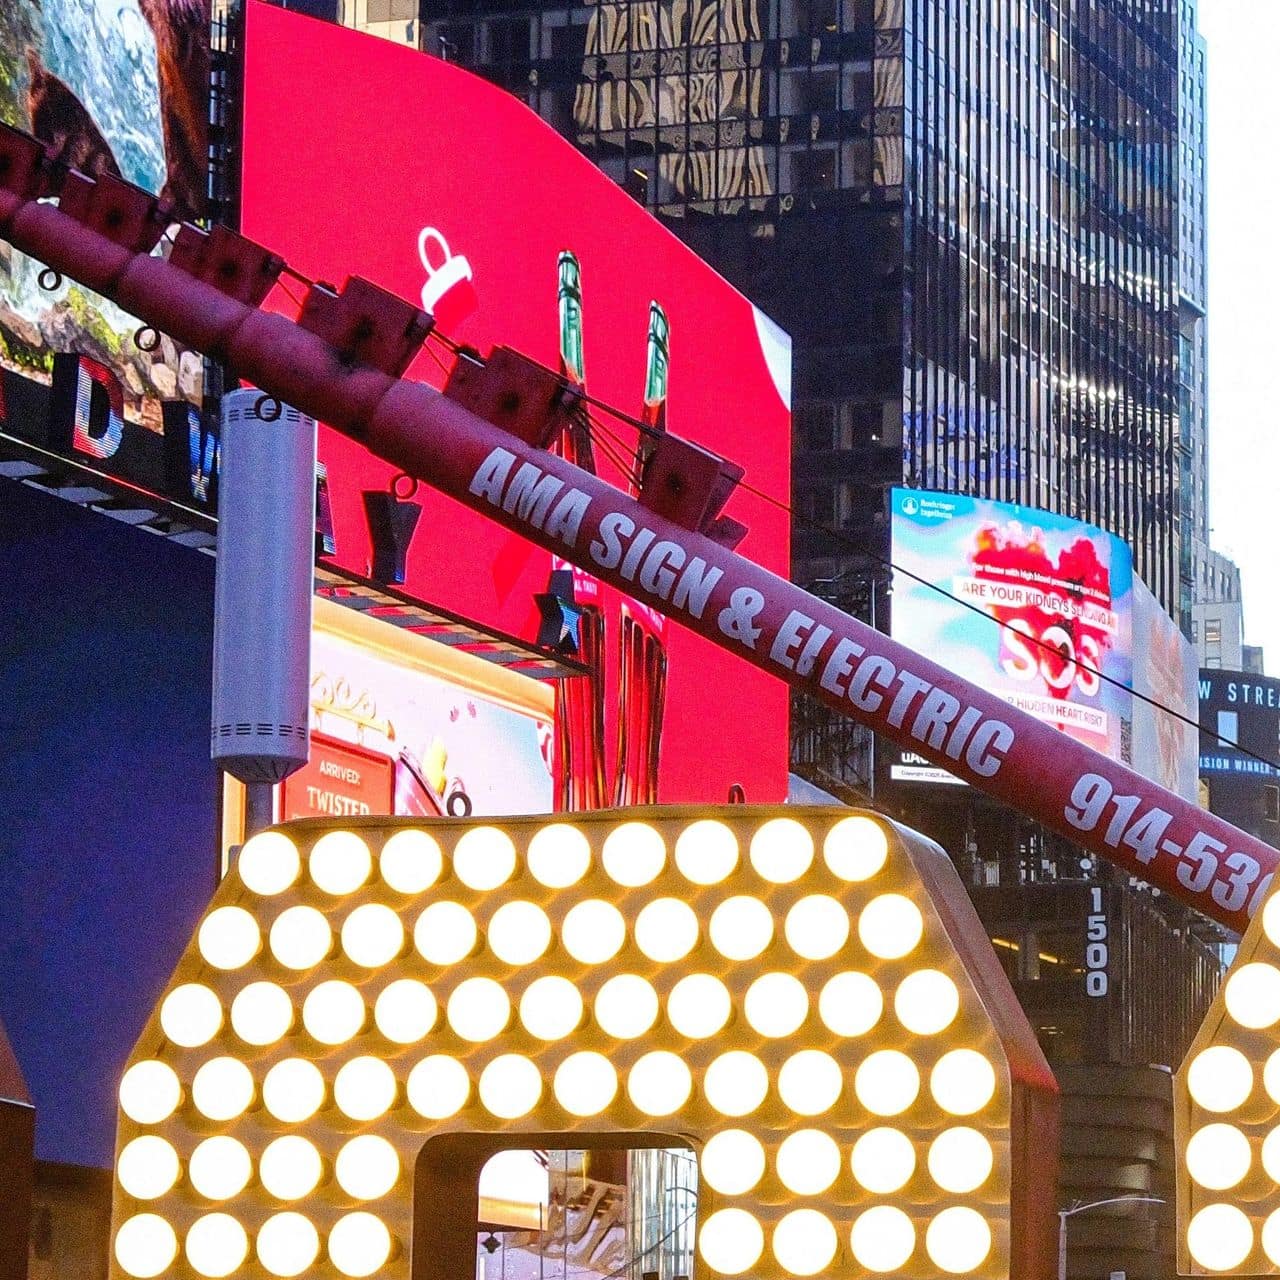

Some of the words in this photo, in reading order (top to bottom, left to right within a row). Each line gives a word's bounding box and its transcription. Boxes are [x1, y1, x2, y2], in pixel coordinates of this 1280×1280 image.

[469, 446, 593, 549] AMA
[589, 511, 724, 620] SIGN
[717, 586, 765, 650] &
[769, 609, 1015, 778] ELECTRIC
[961, 580, 986, 597] ARE
[989, 586, 1023, 605] YOUR
[1025, 591, 1070, 615] KIDNEYS
[1001, 618, 1100, 697] SOS
[1016, 697, 1055, 716] HIDDEN
[1055, 705, 1083, 722] HEART
[319, 759, 361, 786] ARRIVED:
[306, 785, 370, 816] TWISTED
[1086, 887, 1108, 998] 1500
